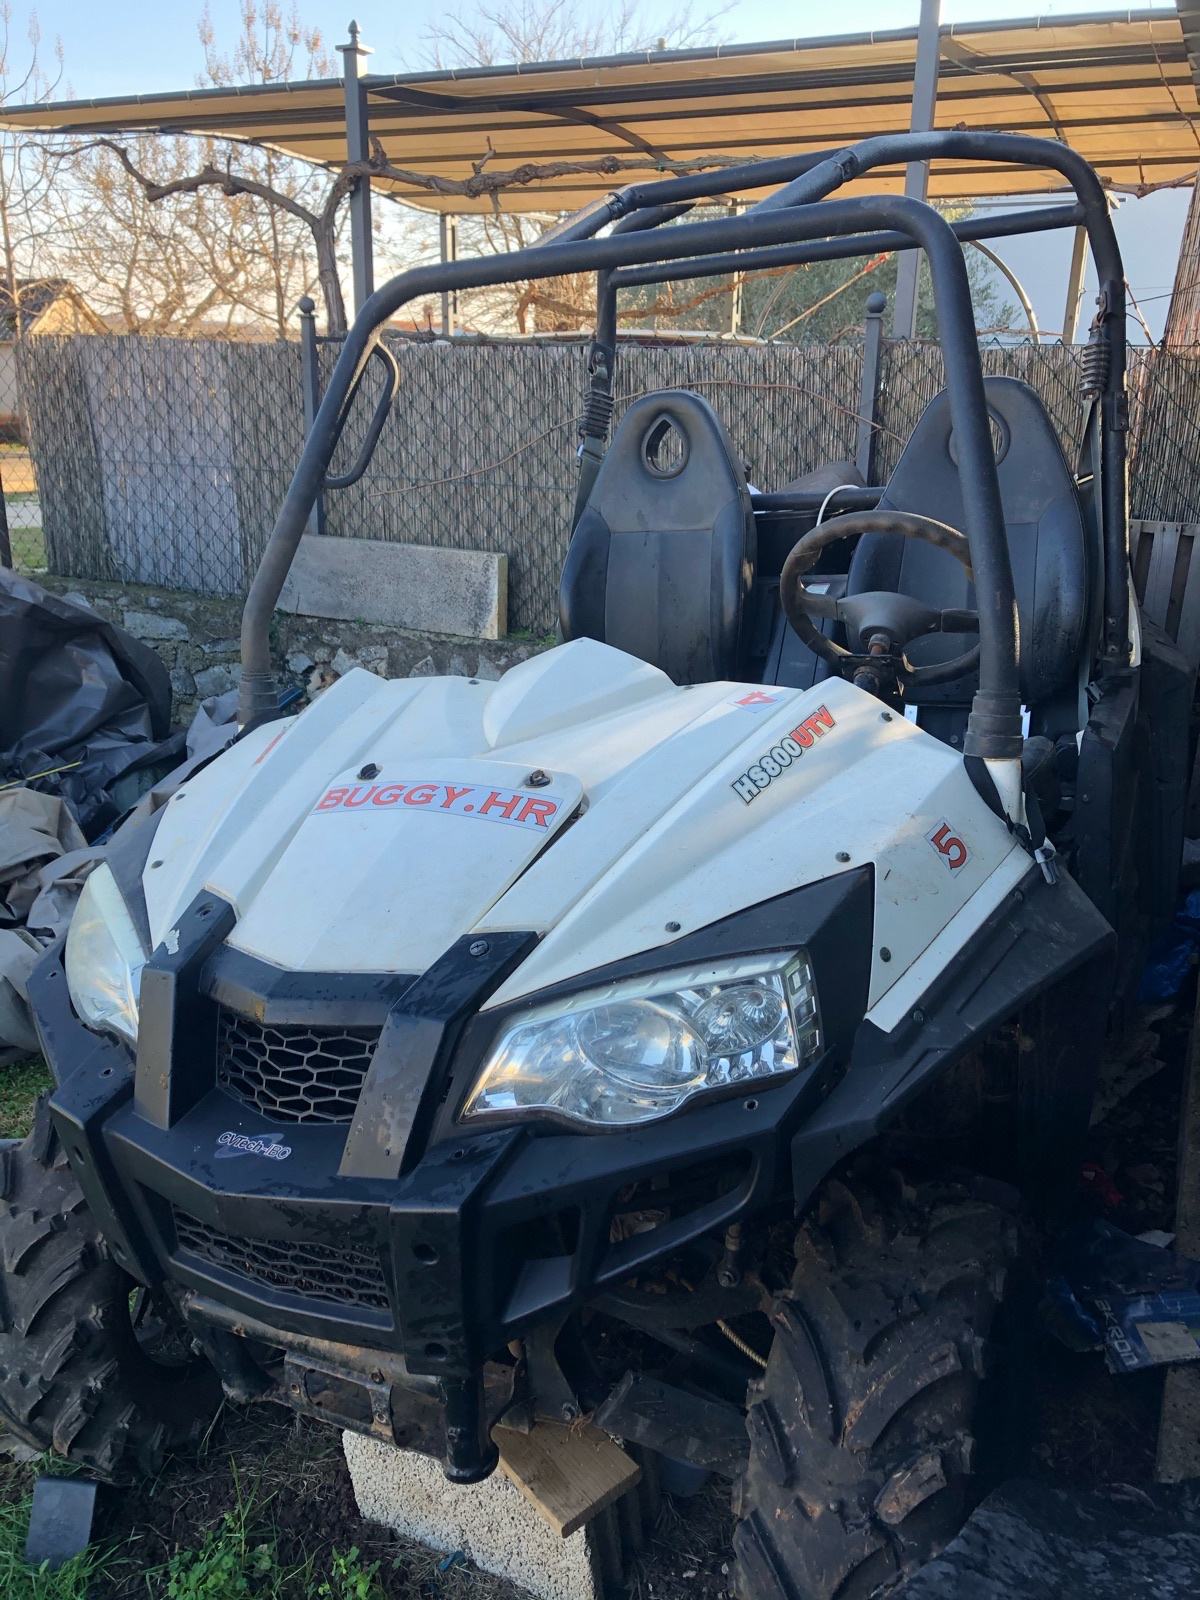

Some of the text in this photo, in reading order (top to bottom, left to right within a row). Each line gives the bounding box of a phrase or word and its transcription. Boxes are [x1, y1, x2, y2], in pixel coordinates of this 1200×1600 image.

[731, 704, 836, 805] HS800UTV
[314, 784, 558, 829] BUGGY.HR
[930, 822, 967, 870] 5
